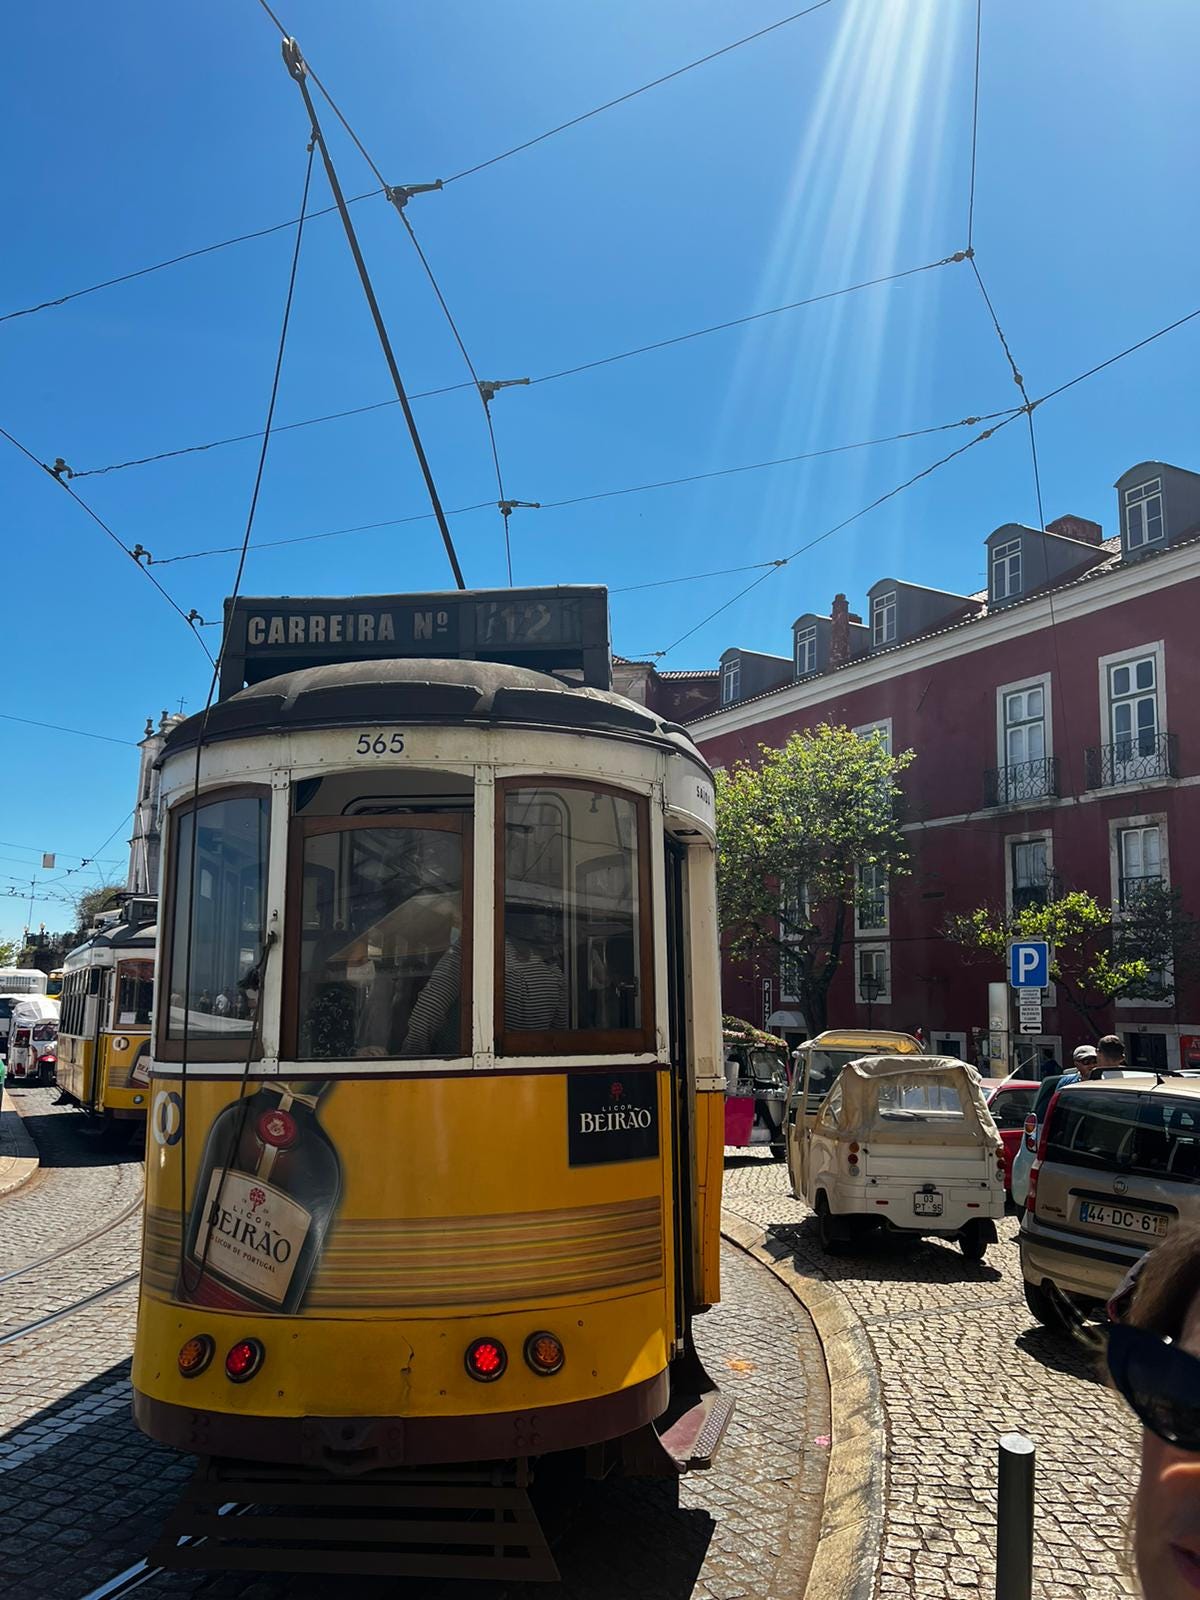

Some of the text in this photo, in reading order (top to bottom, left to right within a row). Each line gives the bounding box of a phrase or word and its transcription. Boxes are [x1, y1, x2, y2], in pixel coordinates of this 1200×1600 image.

[247, 612, 395, 645] CARREIRA
[356, 733, 404, 754] 565
[1019, 948, 1039, 983] P
[580, 1107, 651, 1133] BEIRÃO
[602, 1104, 632, 1112] LICOR
[233, 1205, 272, 1228] LICOR
[207, 1200, 291, 1263] BEIRÃO
